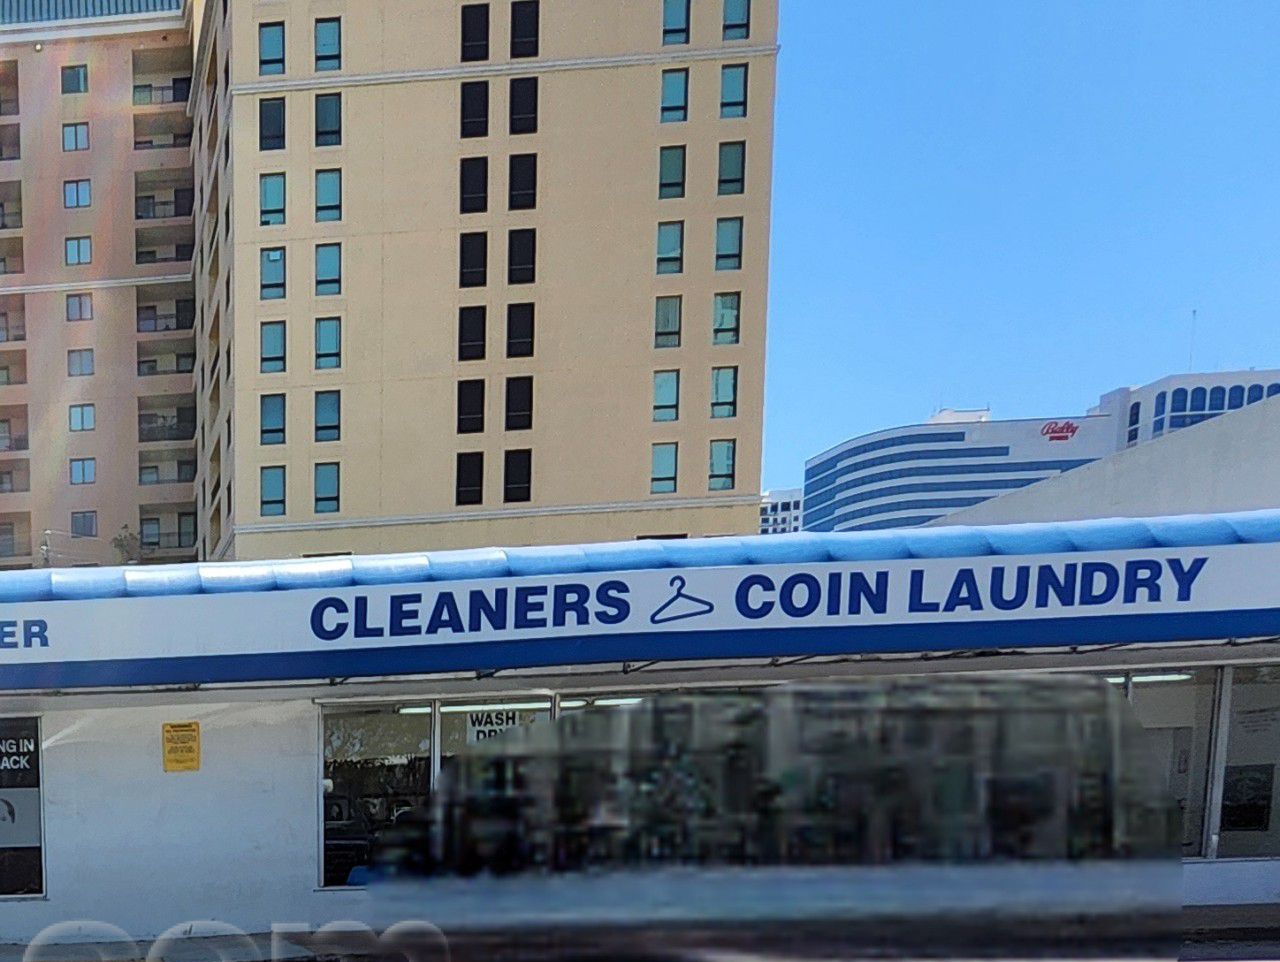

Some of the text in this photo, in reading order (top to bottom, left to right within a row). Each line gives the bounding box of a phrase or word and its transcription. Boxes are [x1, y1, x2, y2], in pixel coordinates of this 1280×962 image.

[1040, 421, 1079, 438] Bally
[309, 557, 1208, 642] CLEANERS COIN LAUNDRY
[469, 711, 516, 727] WASH
[475, 728, 504, 742] DR
[19, 738, 35, 751] IN
